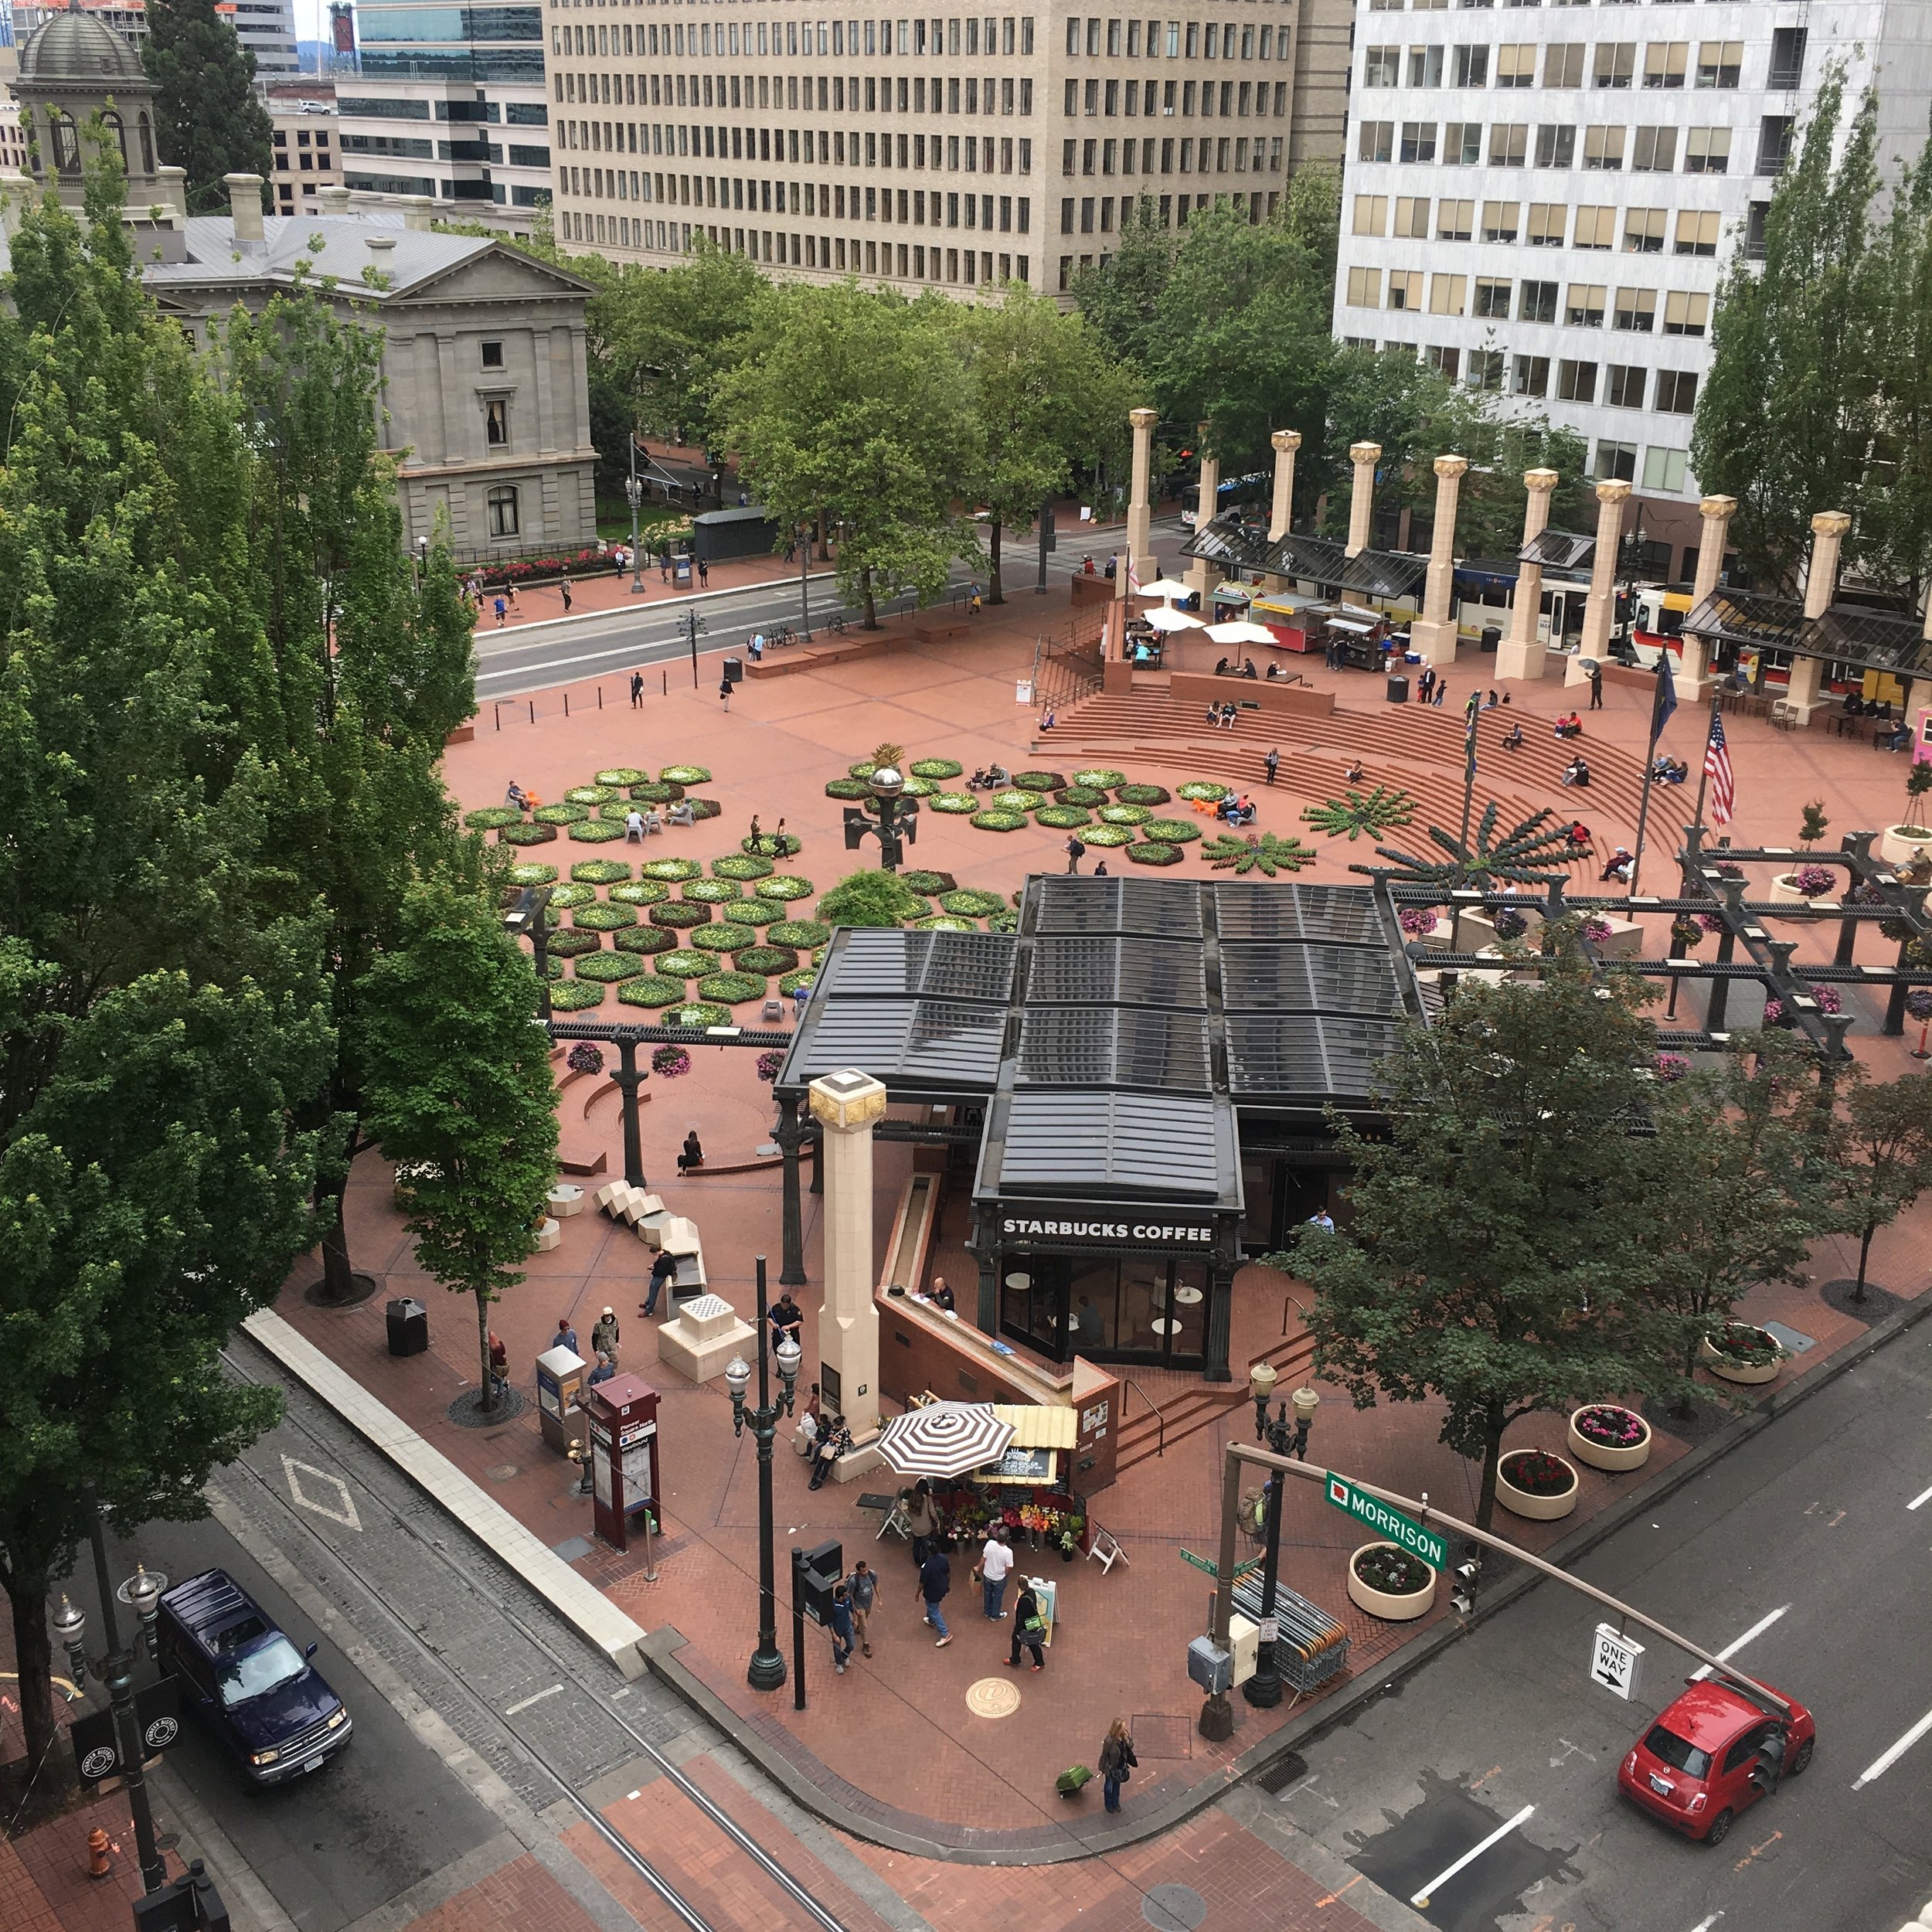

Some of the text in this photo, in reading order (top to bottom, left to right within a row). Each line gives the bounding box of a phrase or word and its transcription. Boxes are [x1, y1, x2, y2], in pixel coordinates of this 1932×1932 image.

[1003, 1219, 1212, 1242] STARBUCKS COFFEE
[620, 1420, 640, 1431] Pioneer
[621, 1425, 639, 1437] Square
[639, 1419, 654, 1429] North
[621, 1437, 648, 1452] Westbound
[1352, 1493, 1441, 1563] MORRISON
[1600, 1652, 1626, 1675] WAY
[1601, 1641, 1627, 1665] ONE
